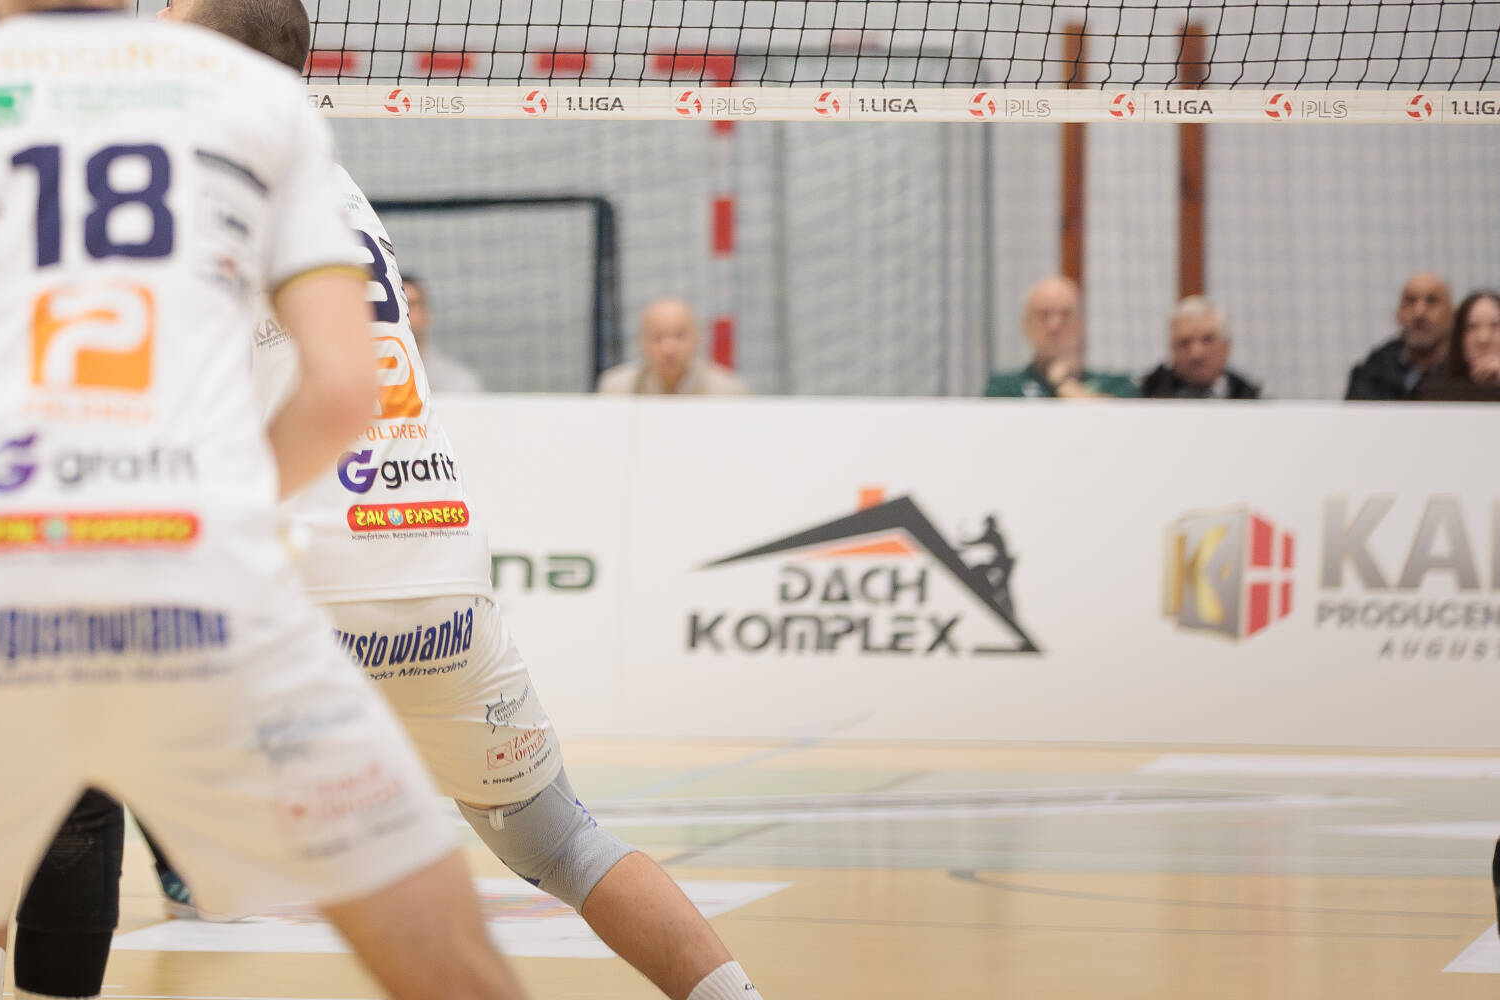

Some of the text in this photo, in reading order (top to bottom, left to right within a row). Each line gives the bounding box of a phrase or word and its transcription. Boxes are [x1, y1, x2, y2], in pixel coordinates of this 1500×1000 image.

[419, 95, 466, 114] PLS
[711, 97, 757, 116] PLS
[1005, 99, 1052, 118] PLS
[1301, 100, 1348, 119] PLS
[12, 143, 175, 268] 18
[357, 423, 428, 441] OLDREN
[380, 452, 457, 490] grafit
[354, 506, 467, 526] ŻAK EXPRESS
[1319, 493, 1500, 591] KA
[777, 564, 929, 604] DACH
[687, 613, 962, 656] KOMPLEX
[1378, 638, 1500, 661] AUGUS
[398, 659, 469, 679] Mineralna
